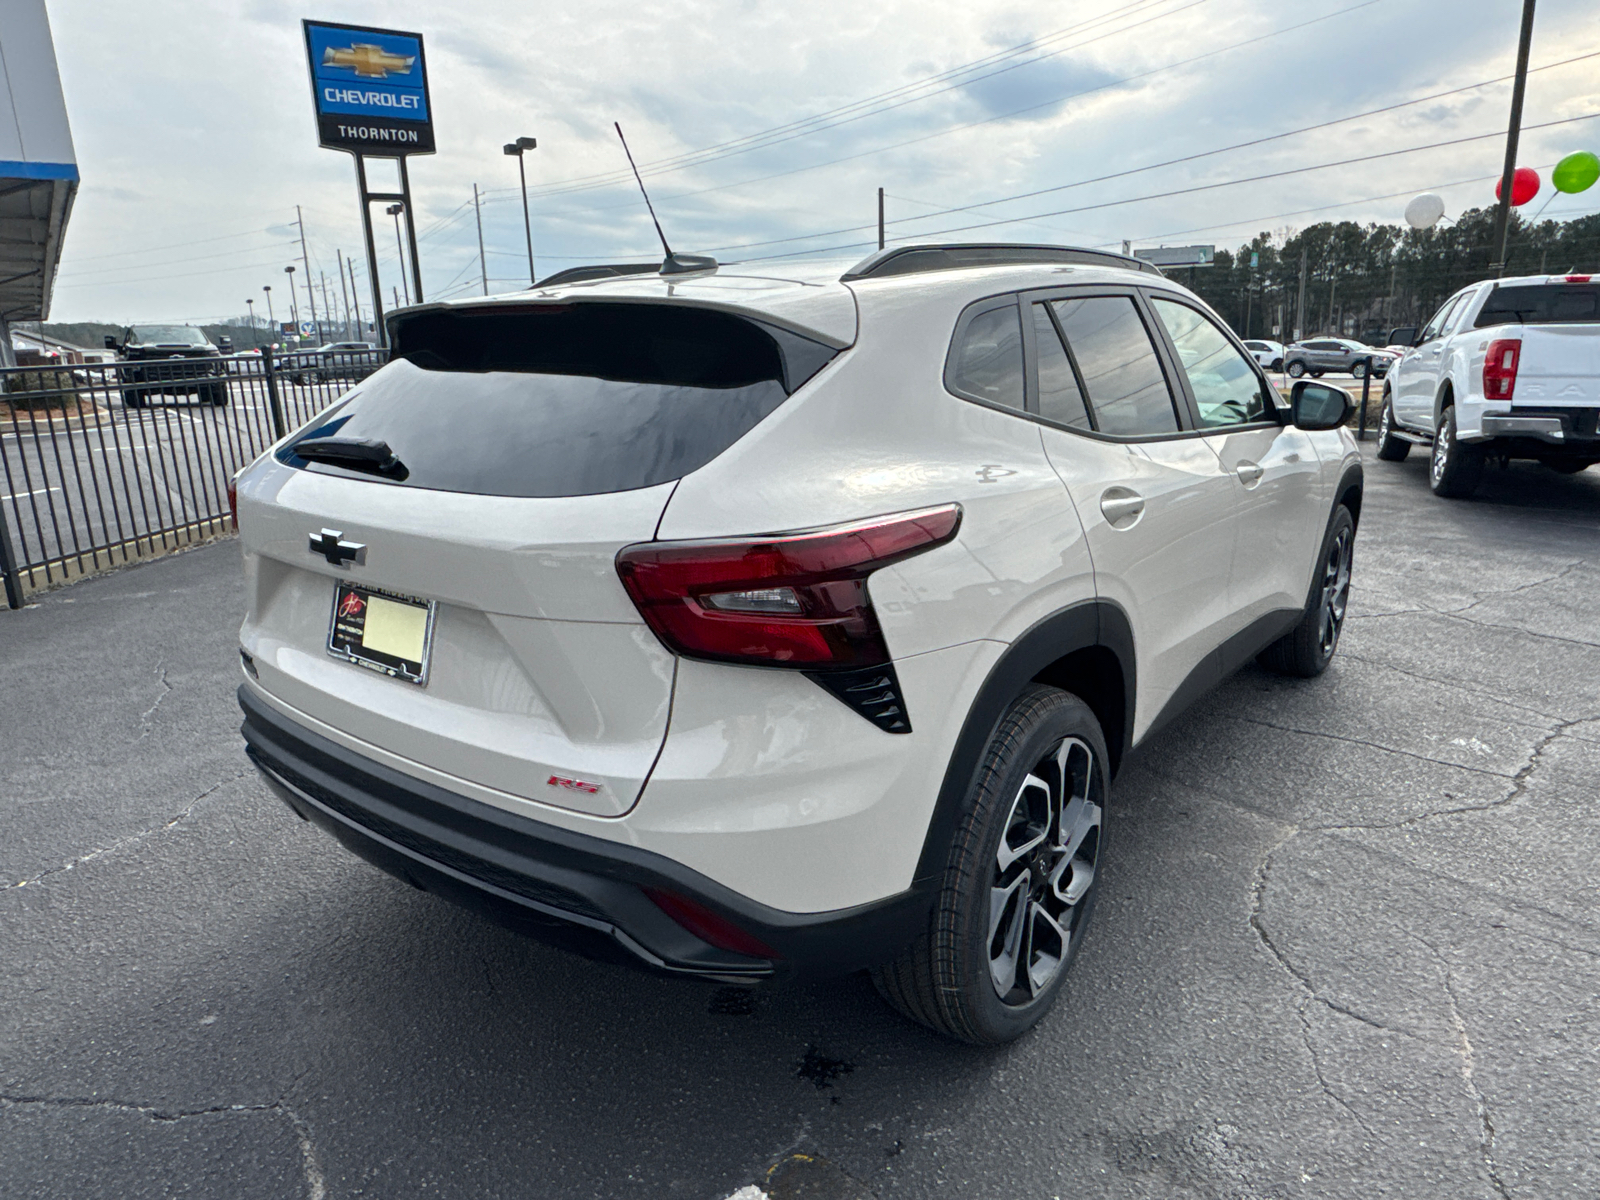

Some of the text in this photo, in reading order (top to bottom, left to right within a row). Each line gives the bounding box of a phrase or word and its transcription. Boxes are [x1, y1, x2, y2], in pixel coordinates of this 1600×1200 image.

[324, 88, 420, 109] CHEVROLET
[338, 125, 418, 142] THORNTON
[547, 774, 603, 794] RS
